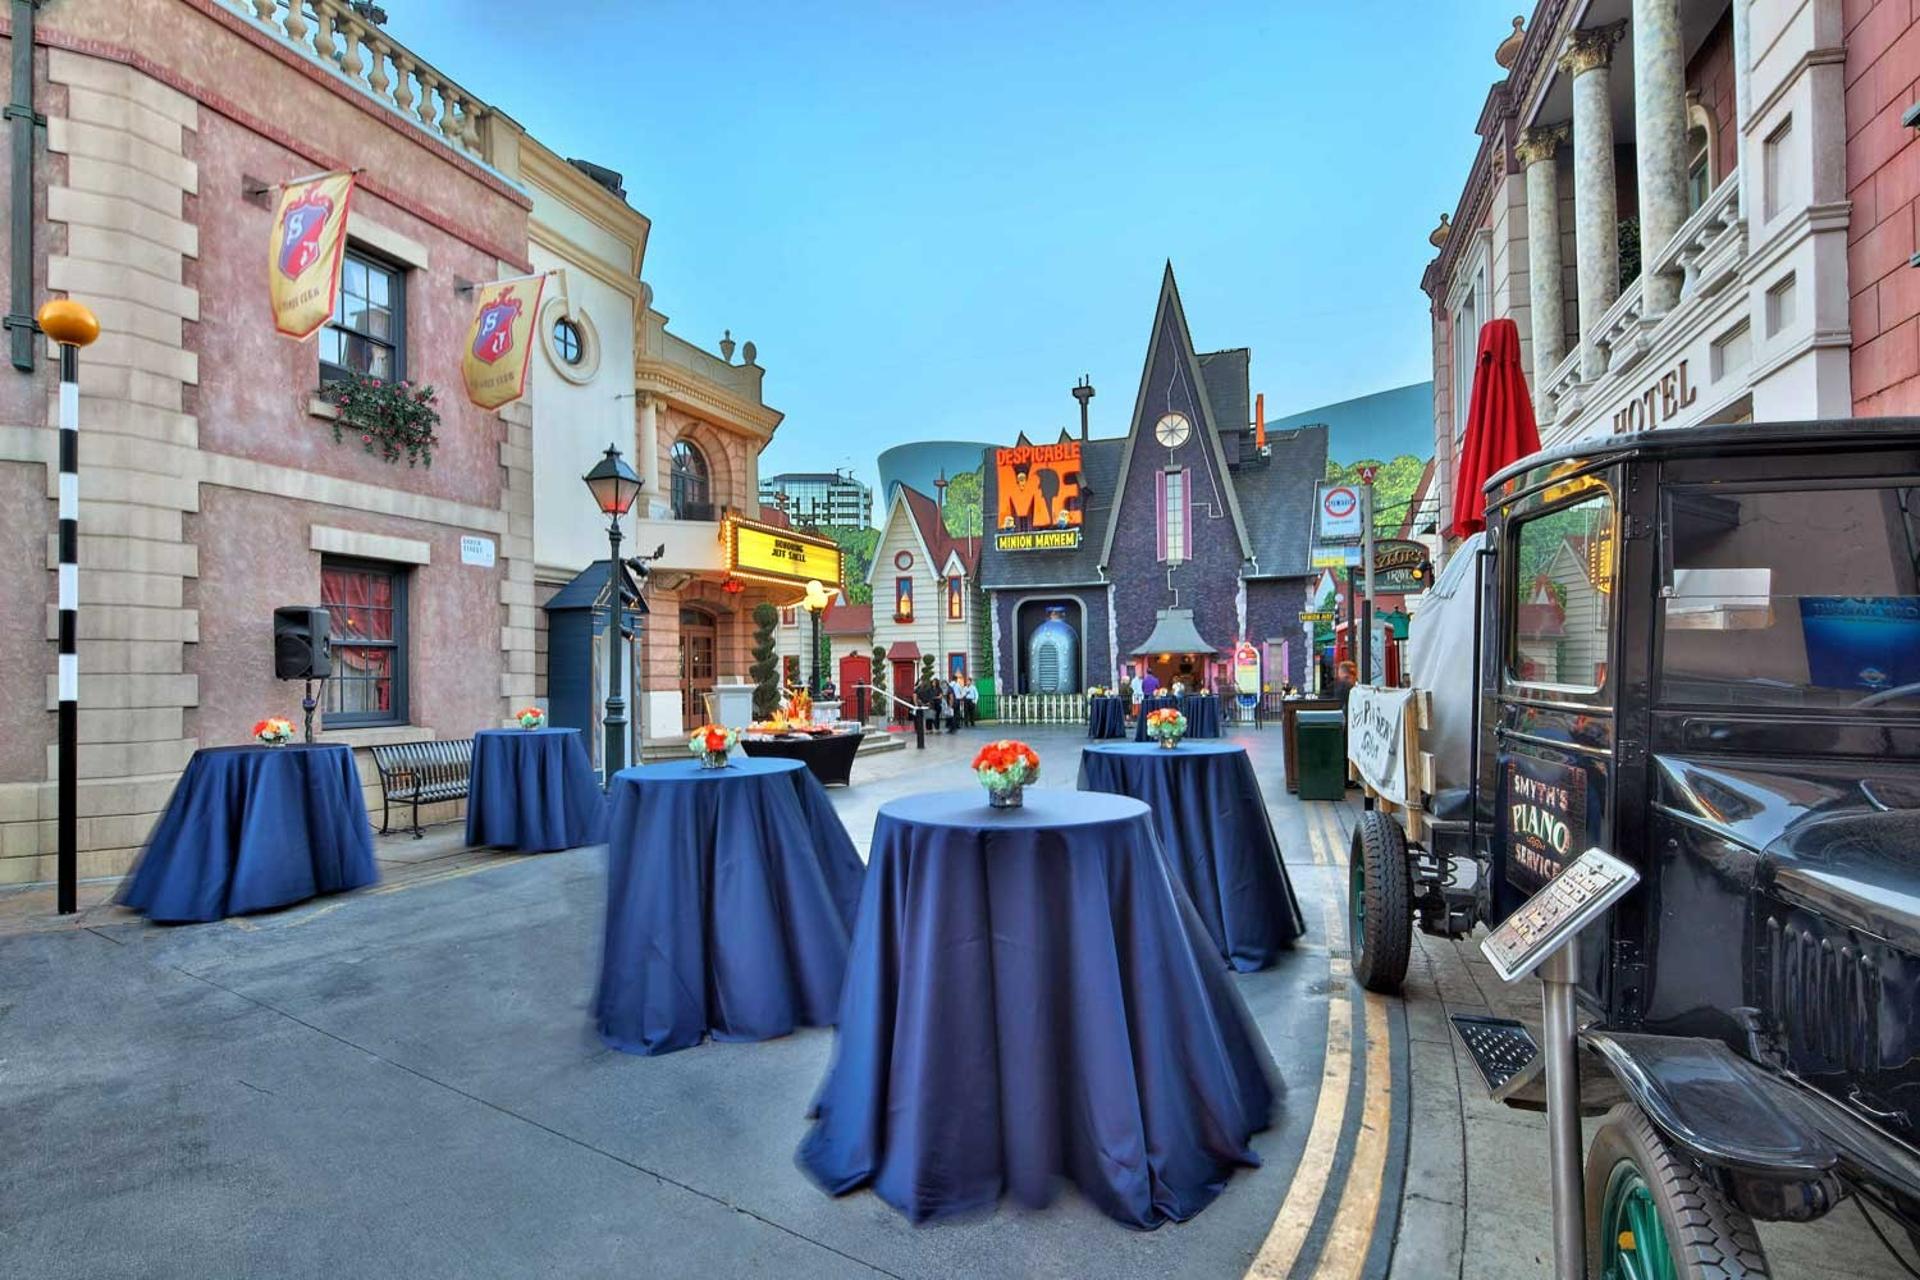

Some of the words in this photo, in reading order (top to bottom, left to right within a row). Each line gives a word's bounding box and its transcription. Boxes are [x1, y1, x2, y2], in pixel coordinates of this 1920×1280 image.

[1613, 359, 1697, 435] HOTEL
[996, 441, 1081, 467] DESPICABLE
[997, 459, 1083, 530] ME
[999, 534, 1033, 550] MINION
[1035, 531, 1076, 548] MAYHEM
[1513, 774, 1569, 812] SMYTH'S
[1511, 803, 1571, 855] PIANO
[1514, 842, 1565, 882] SERVICE
